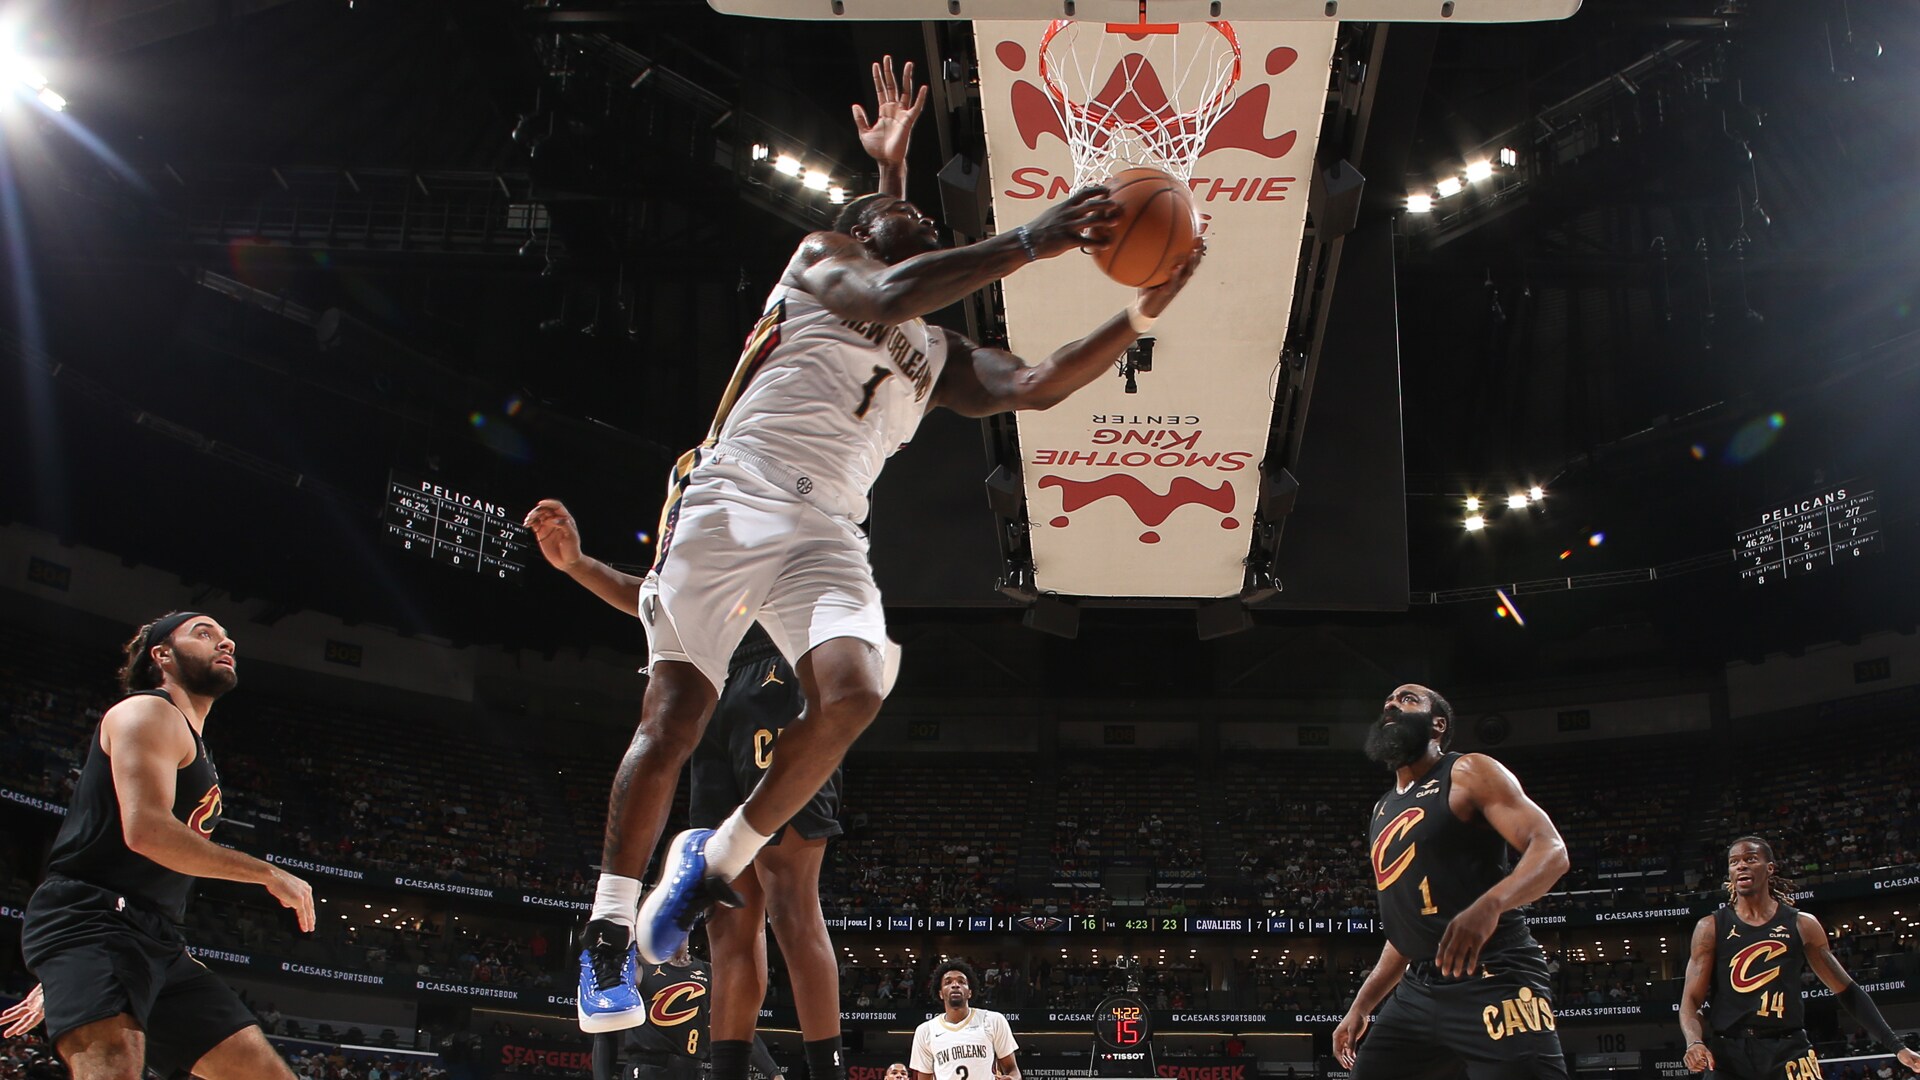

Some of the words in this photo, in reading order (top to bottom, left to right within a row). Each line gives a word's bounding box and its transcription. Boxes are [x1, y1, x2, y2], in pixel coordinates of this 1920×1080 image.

[853, 364, 895, 421] 1
[1091, 414, 1200, 425] CENTER
[1031, 449, 1254, 472] SMOOTHIE
[400, 497, 430, 514] 46.2%
[421, 481, 506, 518] PELICANS
[1761, 488, 1847, 525] PELICANS
[1844, 506, 1861, 518] 2/7
[405, 519, 413, 529] 2
[453, 514, 469, 526] 2/4
[1797, 521, 1813, 533] 2/4
[1850, 527, 1858, 537] 7
[455, 535, 463, 545] 5
[499, 529, 515, 540] 2/7
[404, 540, 412, 550] 8
[1745, 533, 1774, 549] 46.2%
[1803, 541, 1811, 551] 5
[501, 549, 508, 558] 7
[1852, 547, 1860, 557] 6
[453, 555, 460, 564] 0
[1755, 556, 1762, 566] 2
[1805, 562, 1812, 571] 0
[498, 569, 506, 579] 6
[1758, 575, 1765, 585] 8
[0, 788, 43, 808] CAESARS
[1415, 786, 1440, 799] CLIFFS
[1370, 806, 1425, 892] C
[274, 855, 315, 871] CAESARS
[315, 864, 364, 880] SPORTSBOOK
[404, 878, 445, 891] CAESARS
[446, 883, 493, 898] SPORTSBOOK
[531, 895, 570, 908] CAESARS
[1417, 875, 1438, 916] 1
[1603, 909, 1643, 921] CAESARS
[1644, 907, 1690, 919] SPORTSBOOK
[848, 919, 867, 927] FOULS
[876, 919, 882, 928] 3
[917, 919, 924, 928] 6
[957, 918, 964, 928] 7
[974, 919, 987, 927] AST
[997, 919, 1004, 928] 4
[1081, 918, 1096, 929] 16
[1125, 919, 1148, 930] 4:23
[1162, 919, 1177, 930] 23
[1196, 919, 1242, 931] CAVALIERS
[1256, 921, 1262, 929] 7
[1298, 921, 1305, 930] 6
[1336, 921, 1343, 930] 7
[199, 948, 250, 964] SPORTSBOOK
[1728, 939, 1788, 994] C
[290, 963, 332, 978] CAESARS
[333, 971, 384, 985] SPORTSBOOK
[425, 981, 469, 994] CAESARS
[470, 987, 518, 1000] SPORTSBOOK
[650, 981, 707, 1027] C
[1756, 990, 1785, 1019] 14
[851, 1012, 897, 1021] SPORTSBOOK
[1112, 1007, 1140, 1020] 4:22
[1180, 1014, 1220, 1022] CAESARS
[1221, 1013, 1267, 1022] SPORTSBOOK
[1304, 1014, 1343, 1022] CAESARS
[1482, 990, 1556, 1041] CAVS
[1552, 1008, 1593, 1018] CAESARS
[1593, 1006, 1641, 1016] SPORTSBOOK
[1117, 1020, 1138, 1044] 15
[686, 1029, 699, 1055] 8
[1596, 1033, 1626, 1054] 108
[951, 1044, 987, 1060] ORLEANS
[1655, 1061, 1684, 1069] OFFICIAL
